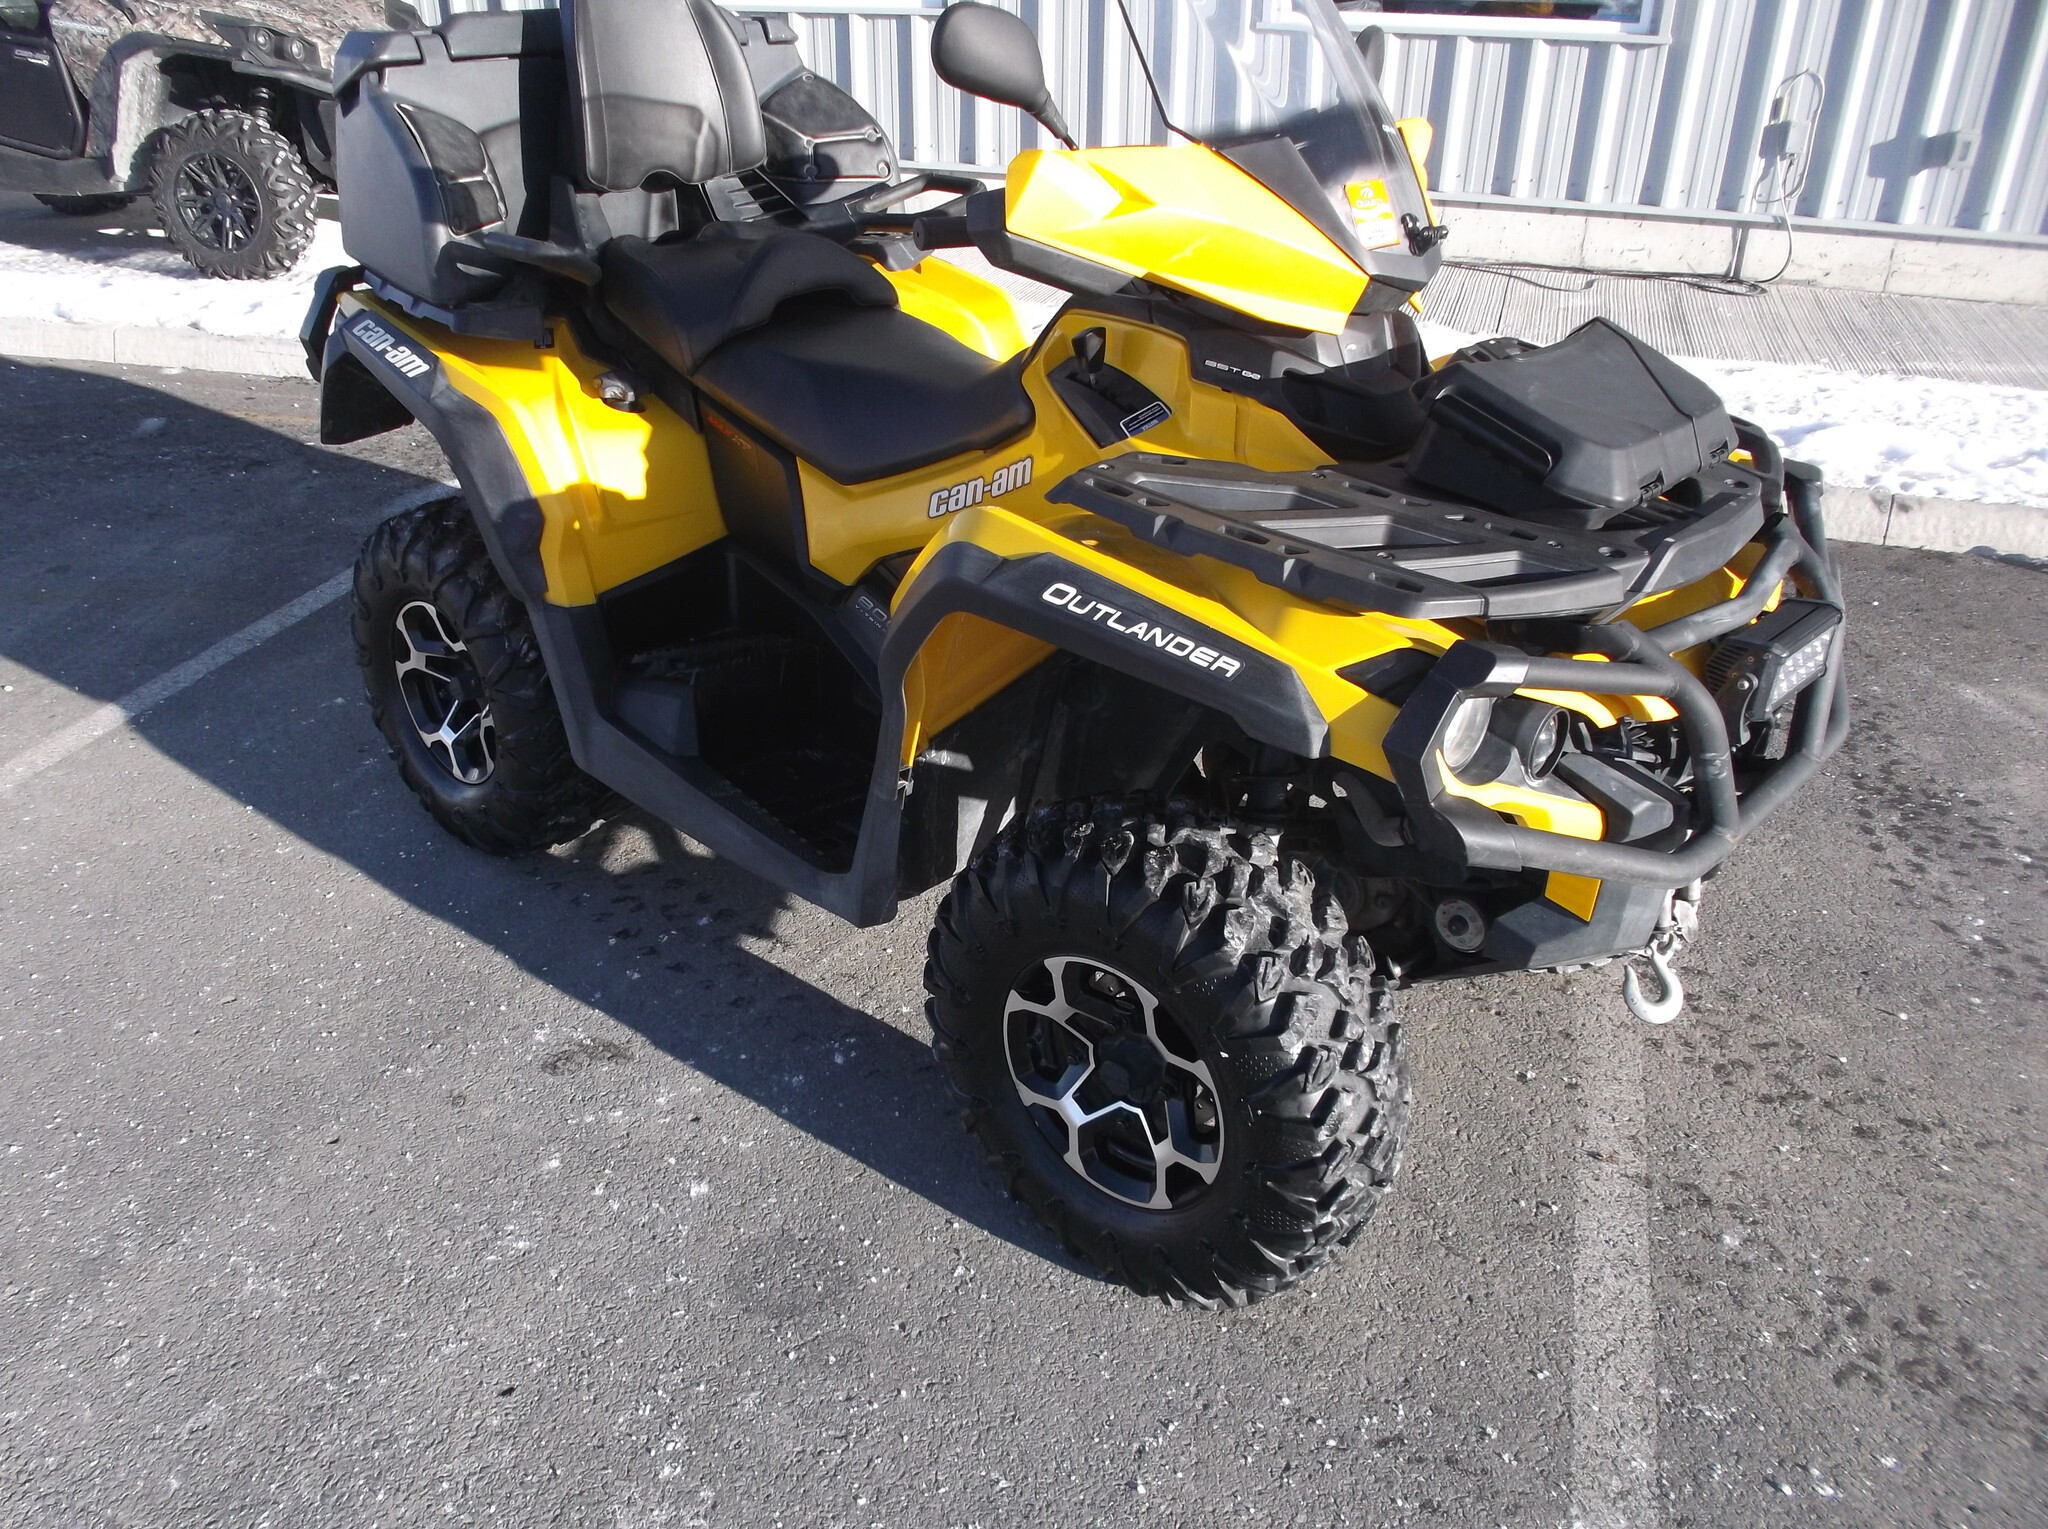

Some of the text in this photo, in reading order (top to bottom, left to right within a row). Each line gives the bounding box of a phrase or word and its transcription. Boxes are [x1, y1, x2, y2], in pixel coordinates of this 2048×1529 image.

[352, 319, 430, 378] can-am
[927, 455, 1033, 518] can-am
[858, 595, 891, 627] 80
[1041, 582, 1241, 678] OUTLANDER
